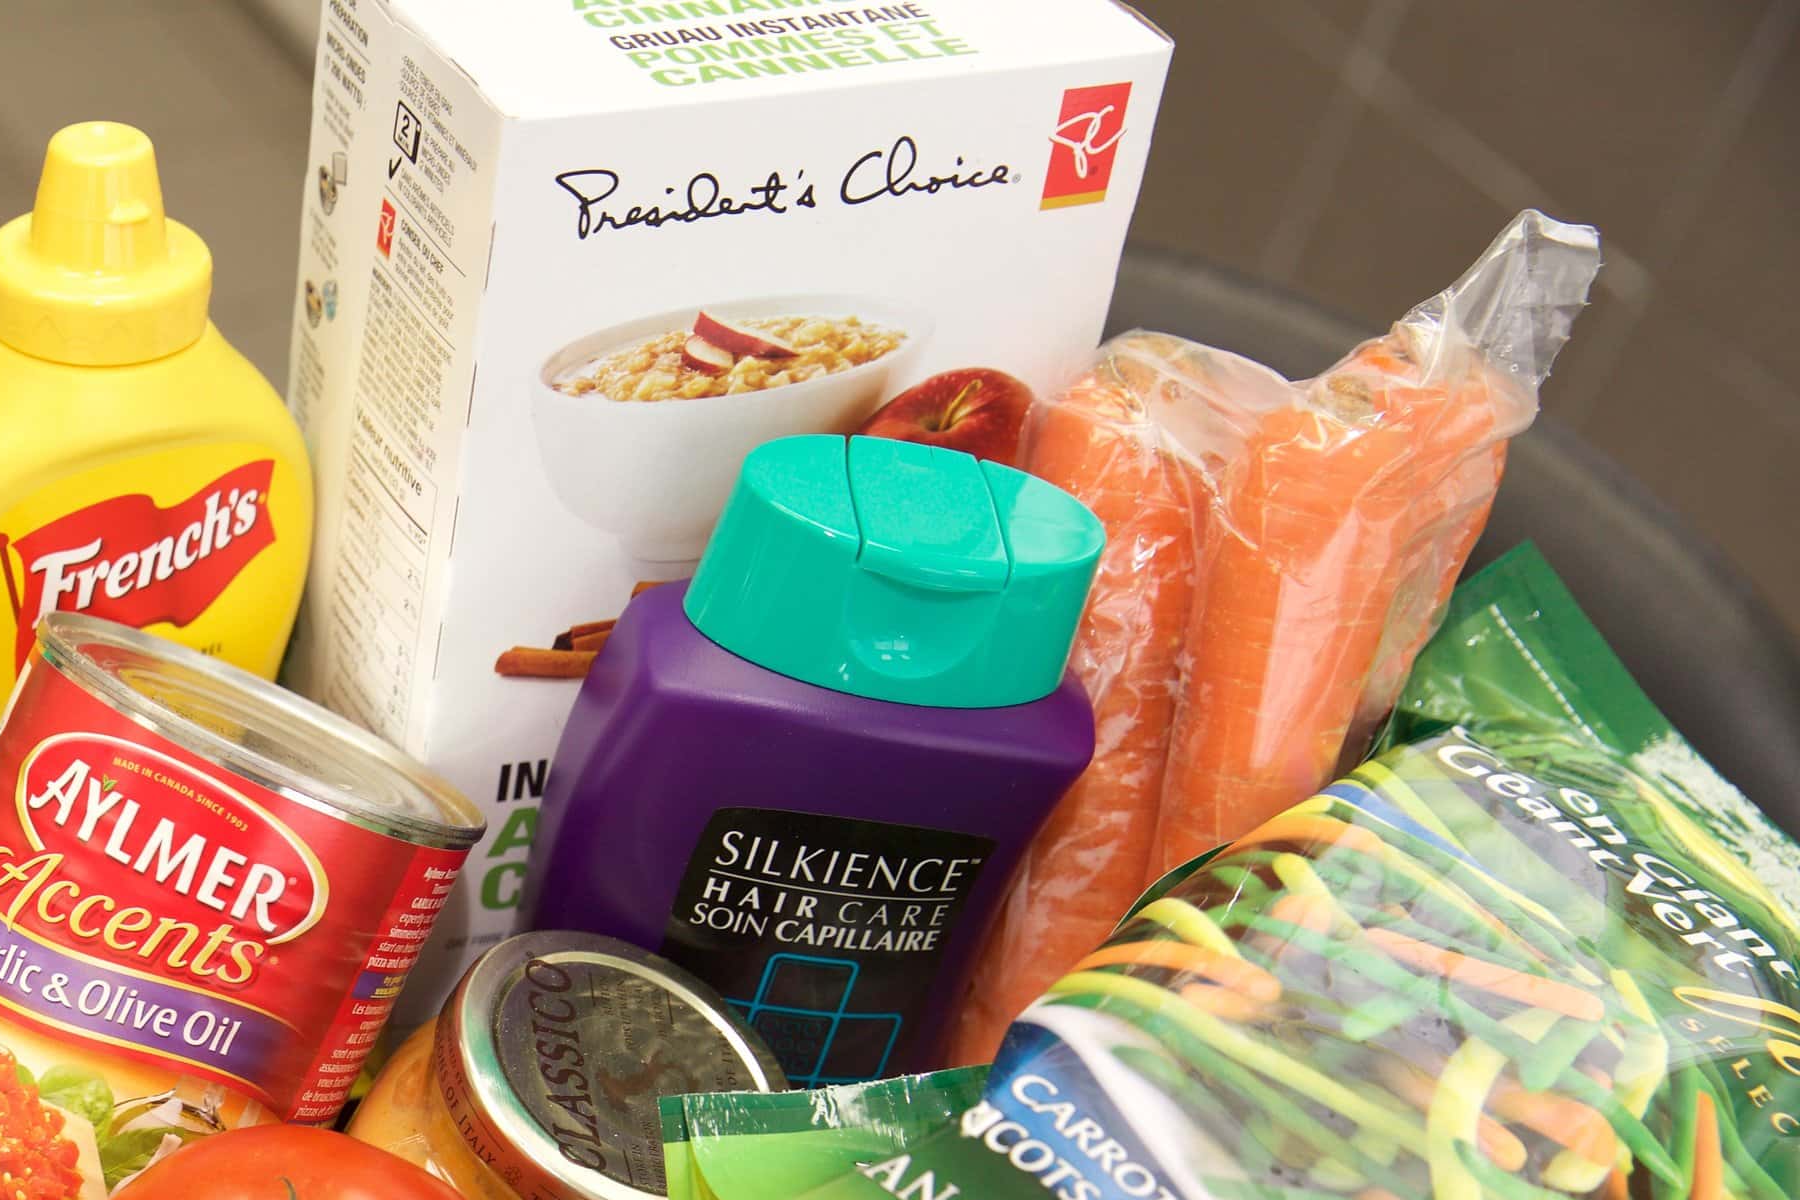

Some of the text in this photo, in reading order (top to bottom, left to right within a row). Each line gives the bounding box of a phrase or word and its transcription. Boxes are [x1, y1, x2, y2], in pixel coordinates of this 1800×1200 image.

[609, 3, 931, 50] GRUAU INSTANTANÉ
[626, 20, 943, 69] POMMES ET
[649, 37, 980, 87] CANNELLE
[401, 114, 410, 138] 2
[557, 135, 1009, 240] President's Choice
[29, 487, 260, 625] French's
[112, 756, 249, 832] MADE IN CANADA SINCE 1903
[29, 757, 289, 933] AYLMER
[714, 829, 971, 894] SILKIENCE
[690, 902, 942, 952] SOIN CAPILLAIRE
[701, 876, 950, 927] HAIR CARE
[41, 972, 73, 1009] &
[76, 979, 179, 1039] Olive
[182, 1009, 243, 1057] Oil
[524, 957, 608, 1172] CLASSICO
[457, 1113, 498, 1167] ITALY
